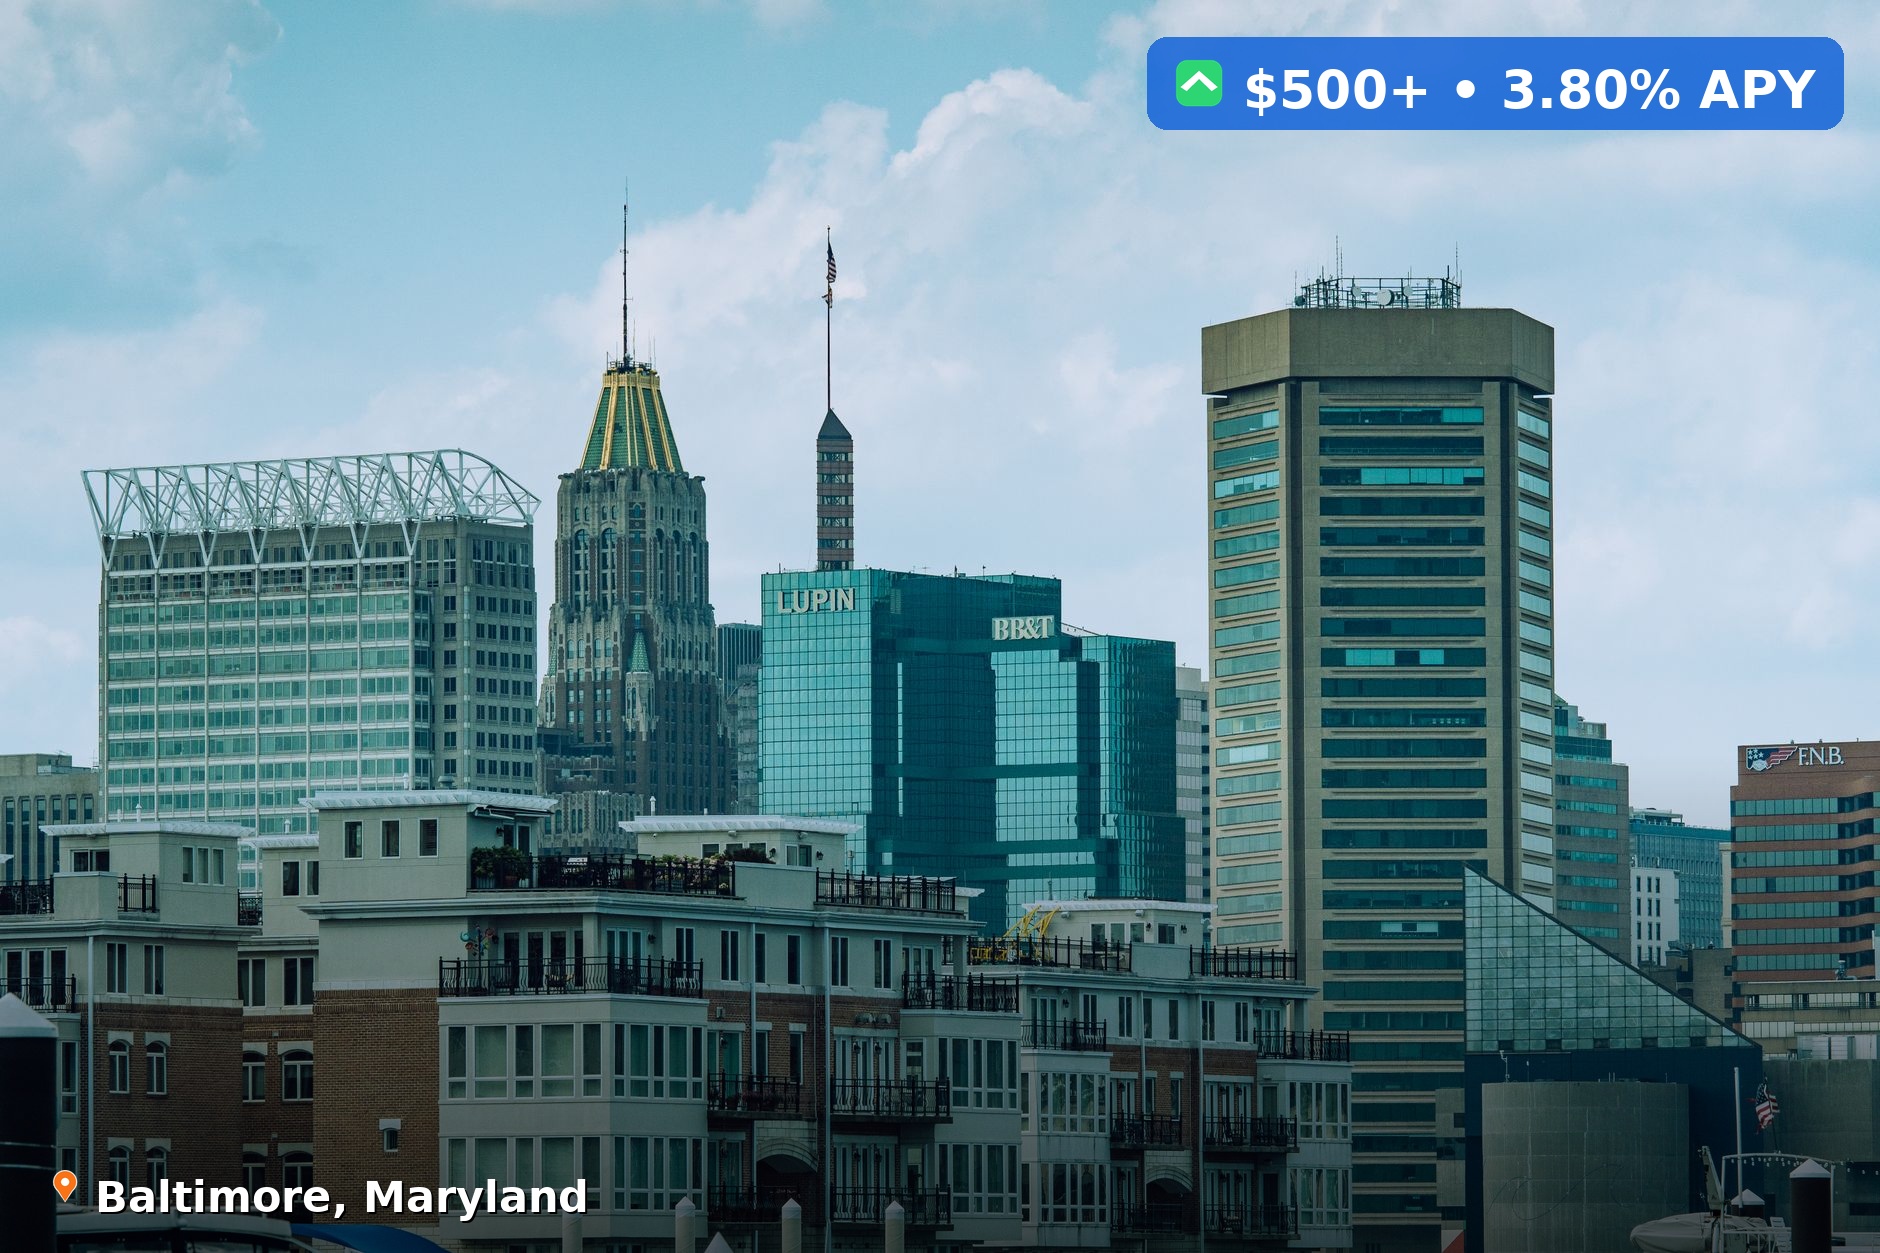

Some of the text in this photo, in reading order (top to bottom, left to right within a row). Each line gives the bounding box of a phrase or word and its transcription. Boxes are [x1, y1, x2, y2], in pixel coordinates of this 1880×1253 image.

[777, 587, 855, 614] LUPIN
[992, 615, 1054, 641] BB&T
[1798, 746, 1845, 766] F.N.B.
